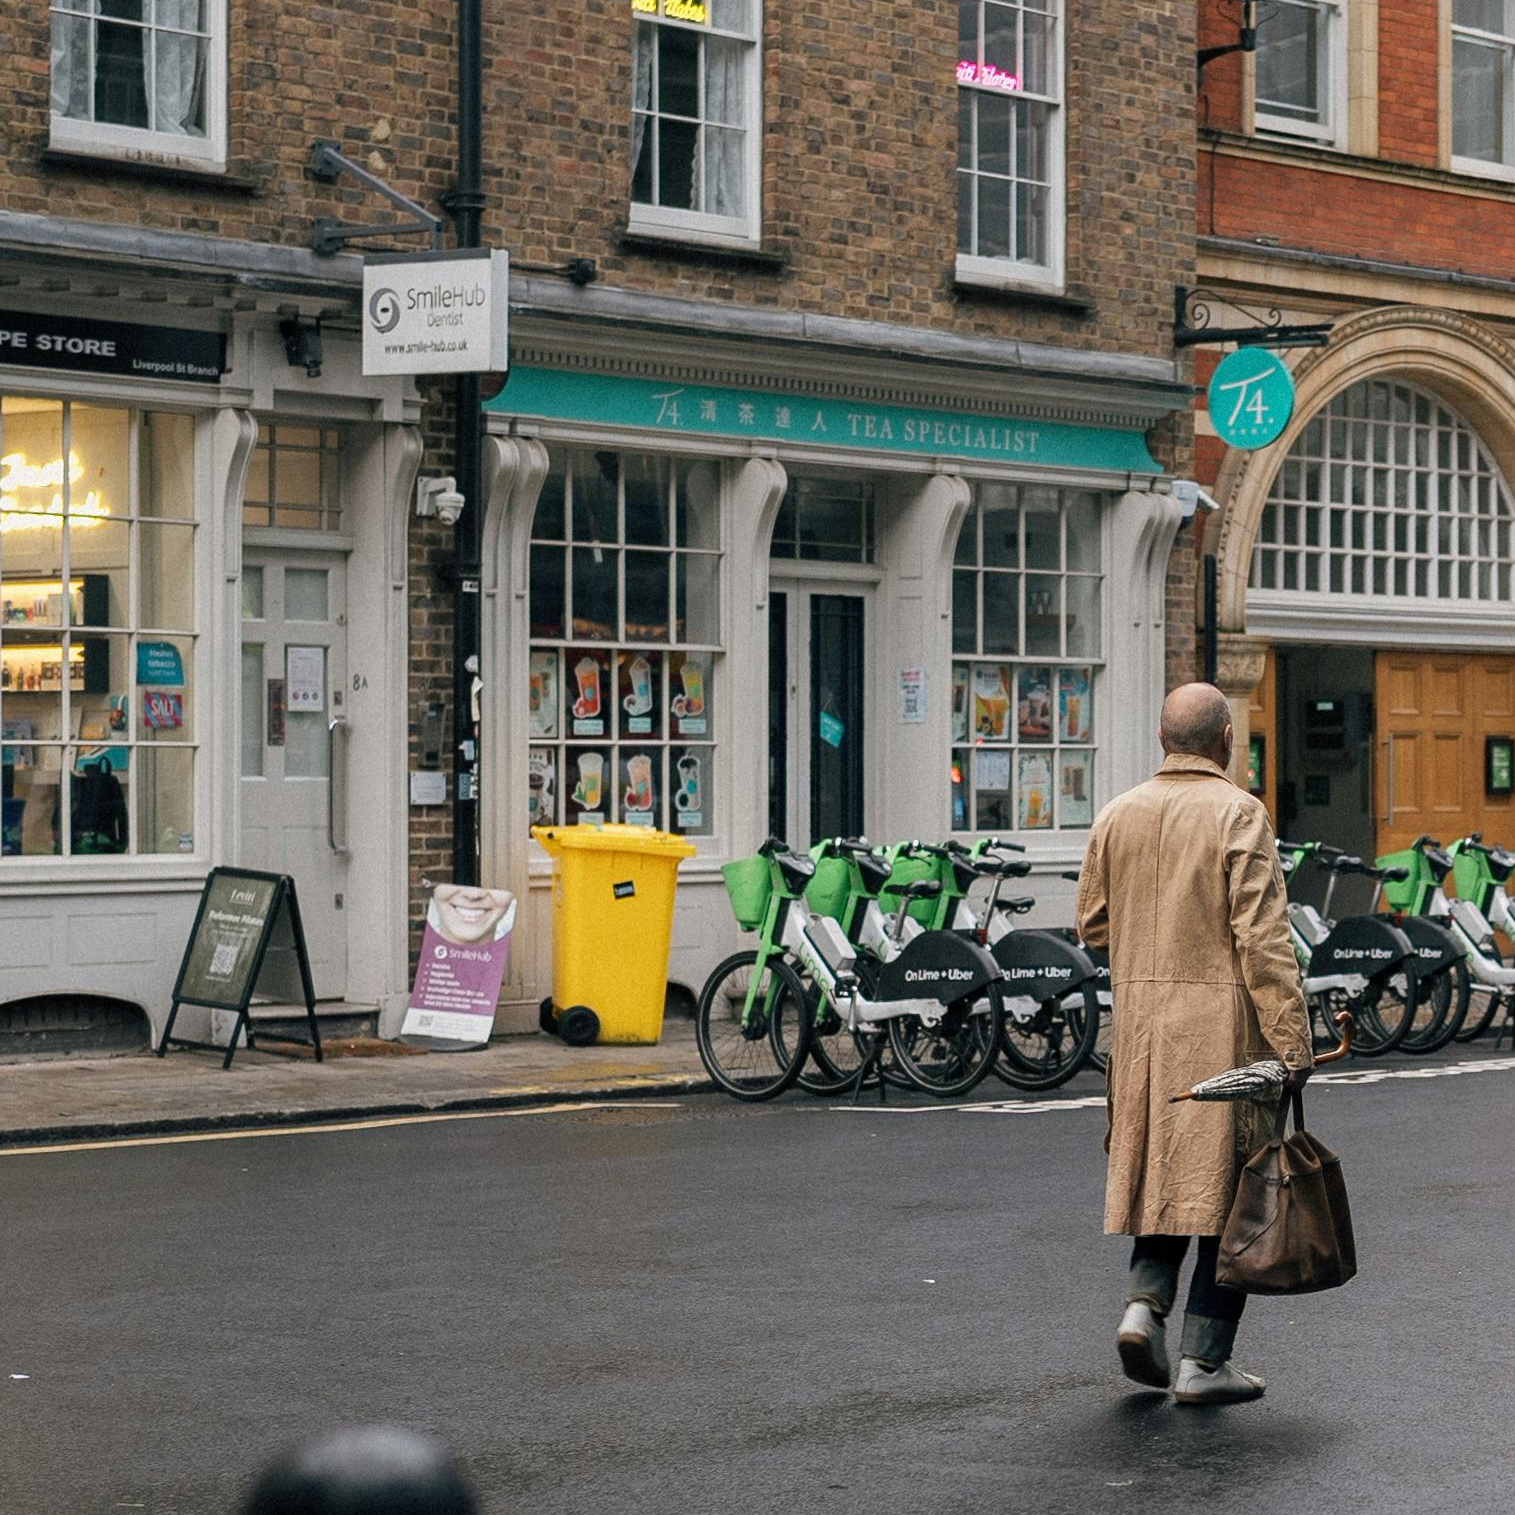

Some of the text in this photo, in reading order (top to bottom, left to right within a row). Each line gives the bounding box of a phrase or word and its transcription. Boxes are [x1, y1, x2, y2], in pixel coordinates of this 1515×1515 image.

[407, 283, 487, 311] SmileHub
[426, 313, 465, 328] Dentist
[36, 334, 117, 358] STORE
[384, 339, 469, 355] www.smile-hub.co.uk
[132, 358, 219, 377] Liverpool St Branch
[847, 413, 895, 440] TEA
[903, 419, 1041, 454] SPECIALIST
[353, 673, 369, 692] 8A
[150, 698, 176, 718] SALT
[448, 948, 492, 963] SmileHub
[1333, 948, 1345, 959] On
[1345, 948, 1365, 958] Lime
[1371, 948, 1393, 959] Uber
[1419, 948, 1443, 958] Uber
[905, 970, 918, 982] On
[918, 969, 941, 981] Lime
[948, 968, 975, 981] Uber
[1011, 968, 1036, 979] Lime
[1044, 966, 1072, 978] Uber
